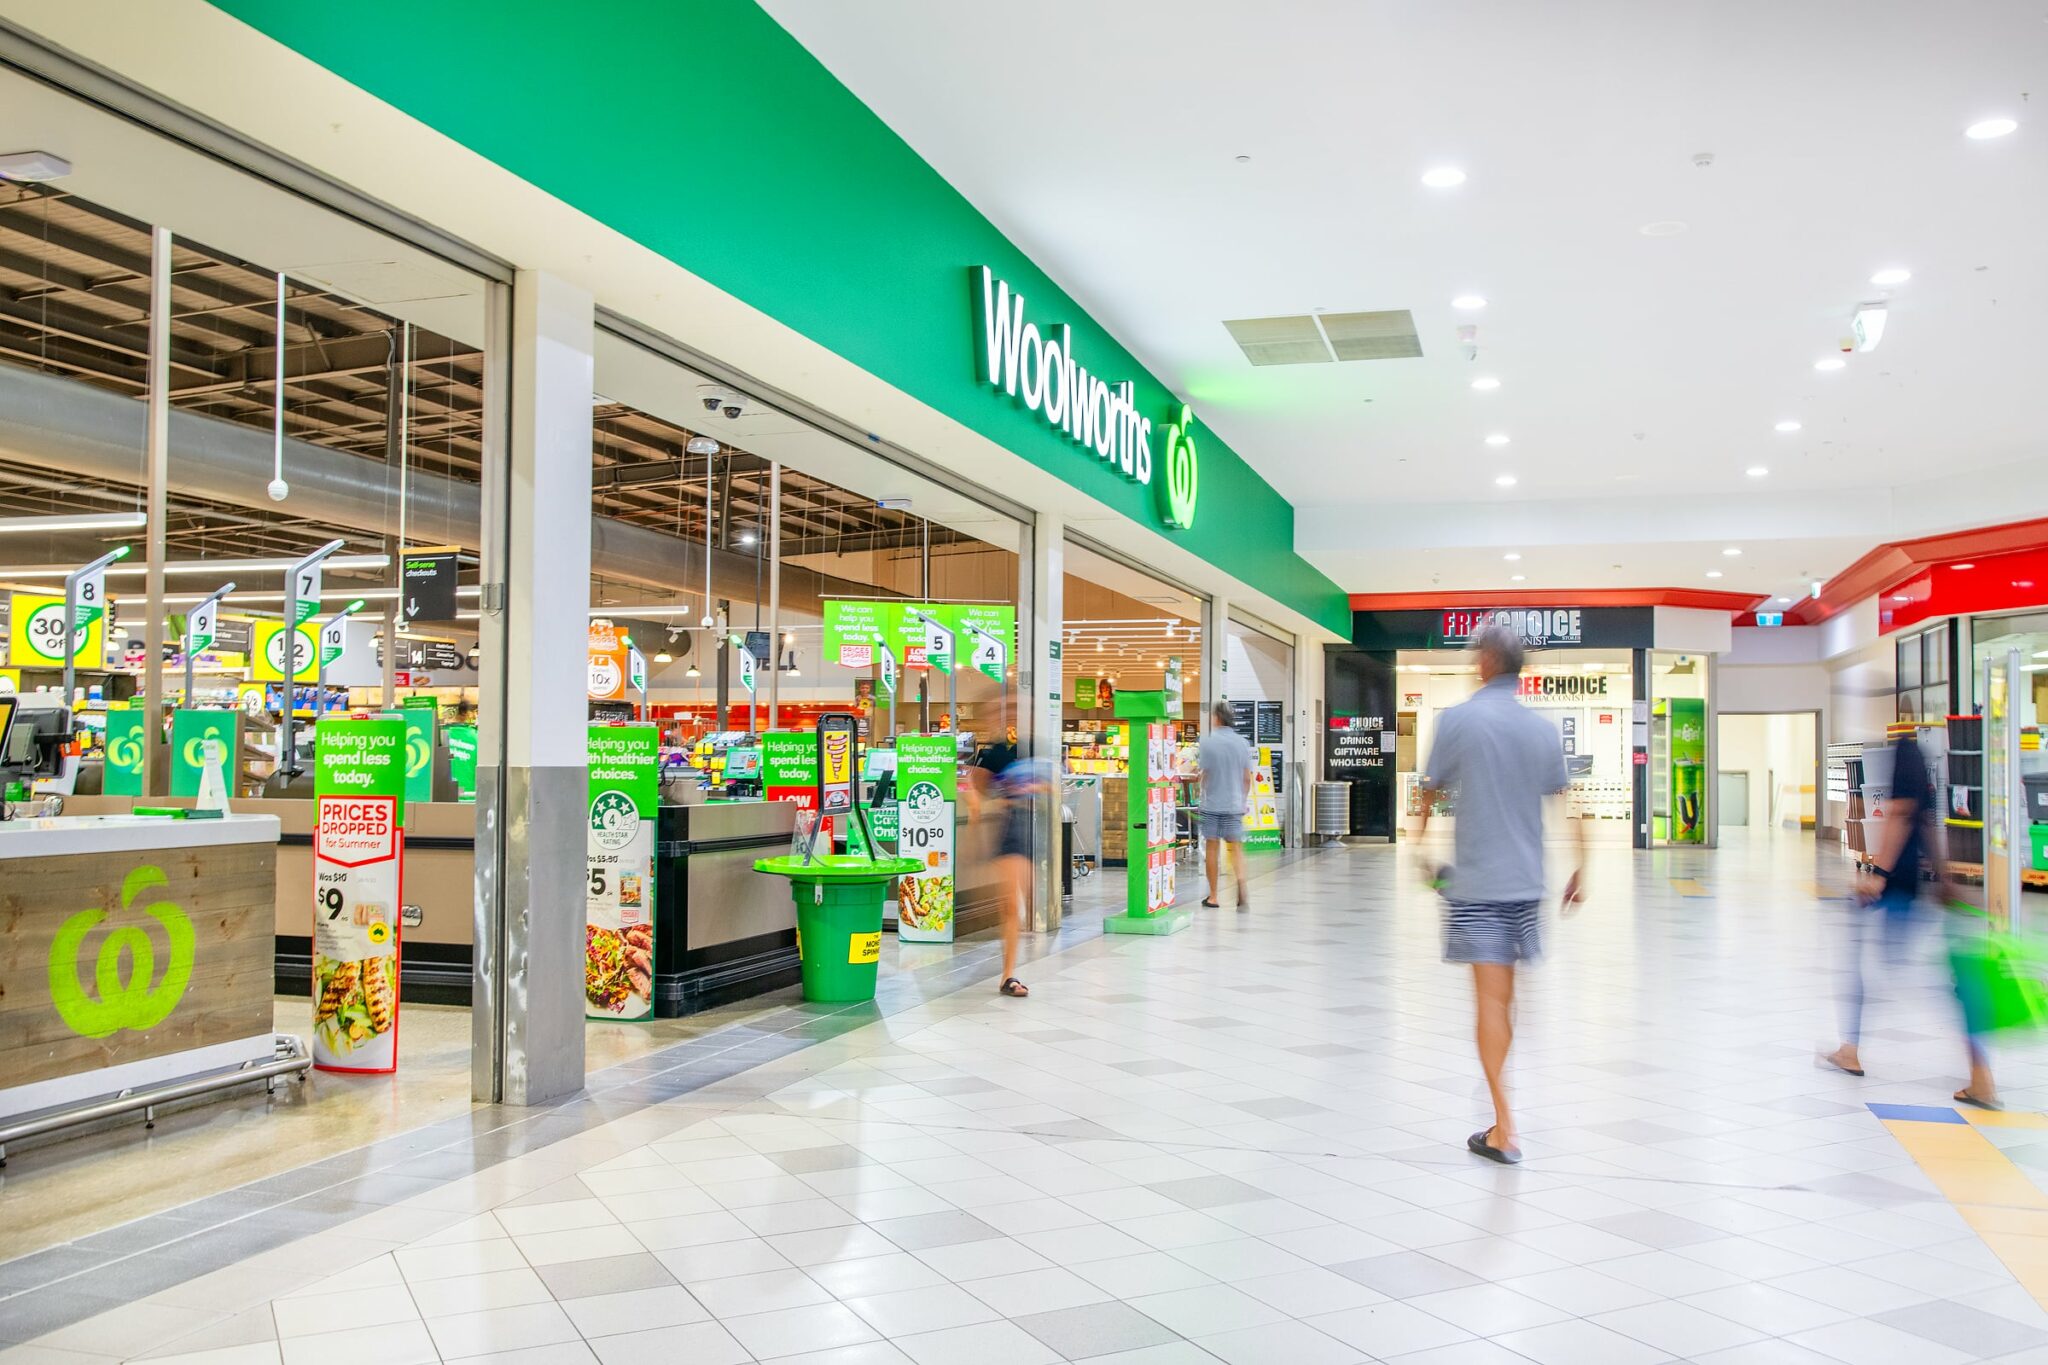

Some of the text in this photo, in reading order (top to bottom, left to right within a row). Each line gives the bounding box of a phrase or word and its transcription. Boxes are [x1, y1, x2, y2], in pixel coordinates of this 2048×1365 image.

[982, 265, 1151, 485] Woolworths
[83, 583, 94, 600] 8
[302, 576, 312, 595] 7
[198, 616, 207, 631] 9
[903, 616, 920, 626] hel
[833, 624, 860, 633] spend
[327, 630, 341, 645] 10
[933, 636, 943, 650] 5
[277, 637, 305, 657] 12
[411, 650, 424, 665] 14
[985, 647, 996, 661] 4
[745, 661, 750, 673] 2
[1515, 676, 1607, 695] REECHOICE
[1524, 694, 1585, 702] TOBACCONIST
[321, 731, 396, 751] Helping you
[626, 740, 650, 752] you
[1340, 736, 1374, 745] DRINKS
[767, 741, 818, 755] Helping yo
[901, 743, 951, 755] Helping you
[1334, 747, 1380, 756] GIFTWARE
[323, 751, 392, 769] spend less
[587, 752, 657, 765] ith healthier
[769, 754, 818, 768] spend les
[898, 753, 956, 764] with healthier
[1329, 758, 1384, 767] WHOLESALE
[591, 767, 639, 780] choices.
[778, 768, 812, 782] today.
[907, 764, 943, 774] choices.
[333, 769, 376, 789] today.
[921, 798, 927, 807] 4
[323, 804, 388, 822] PRICES
[608, 814, 616, 827] 4
[322, 822, 388, 836] DROPPED
[325, 837, 381, 849] for Summer
[587, 855, 597, 863] as
[318, 872, 332, 881] Was
[318, 887, 344, 921] $9
[862, 948, 880, 957] SPINN
